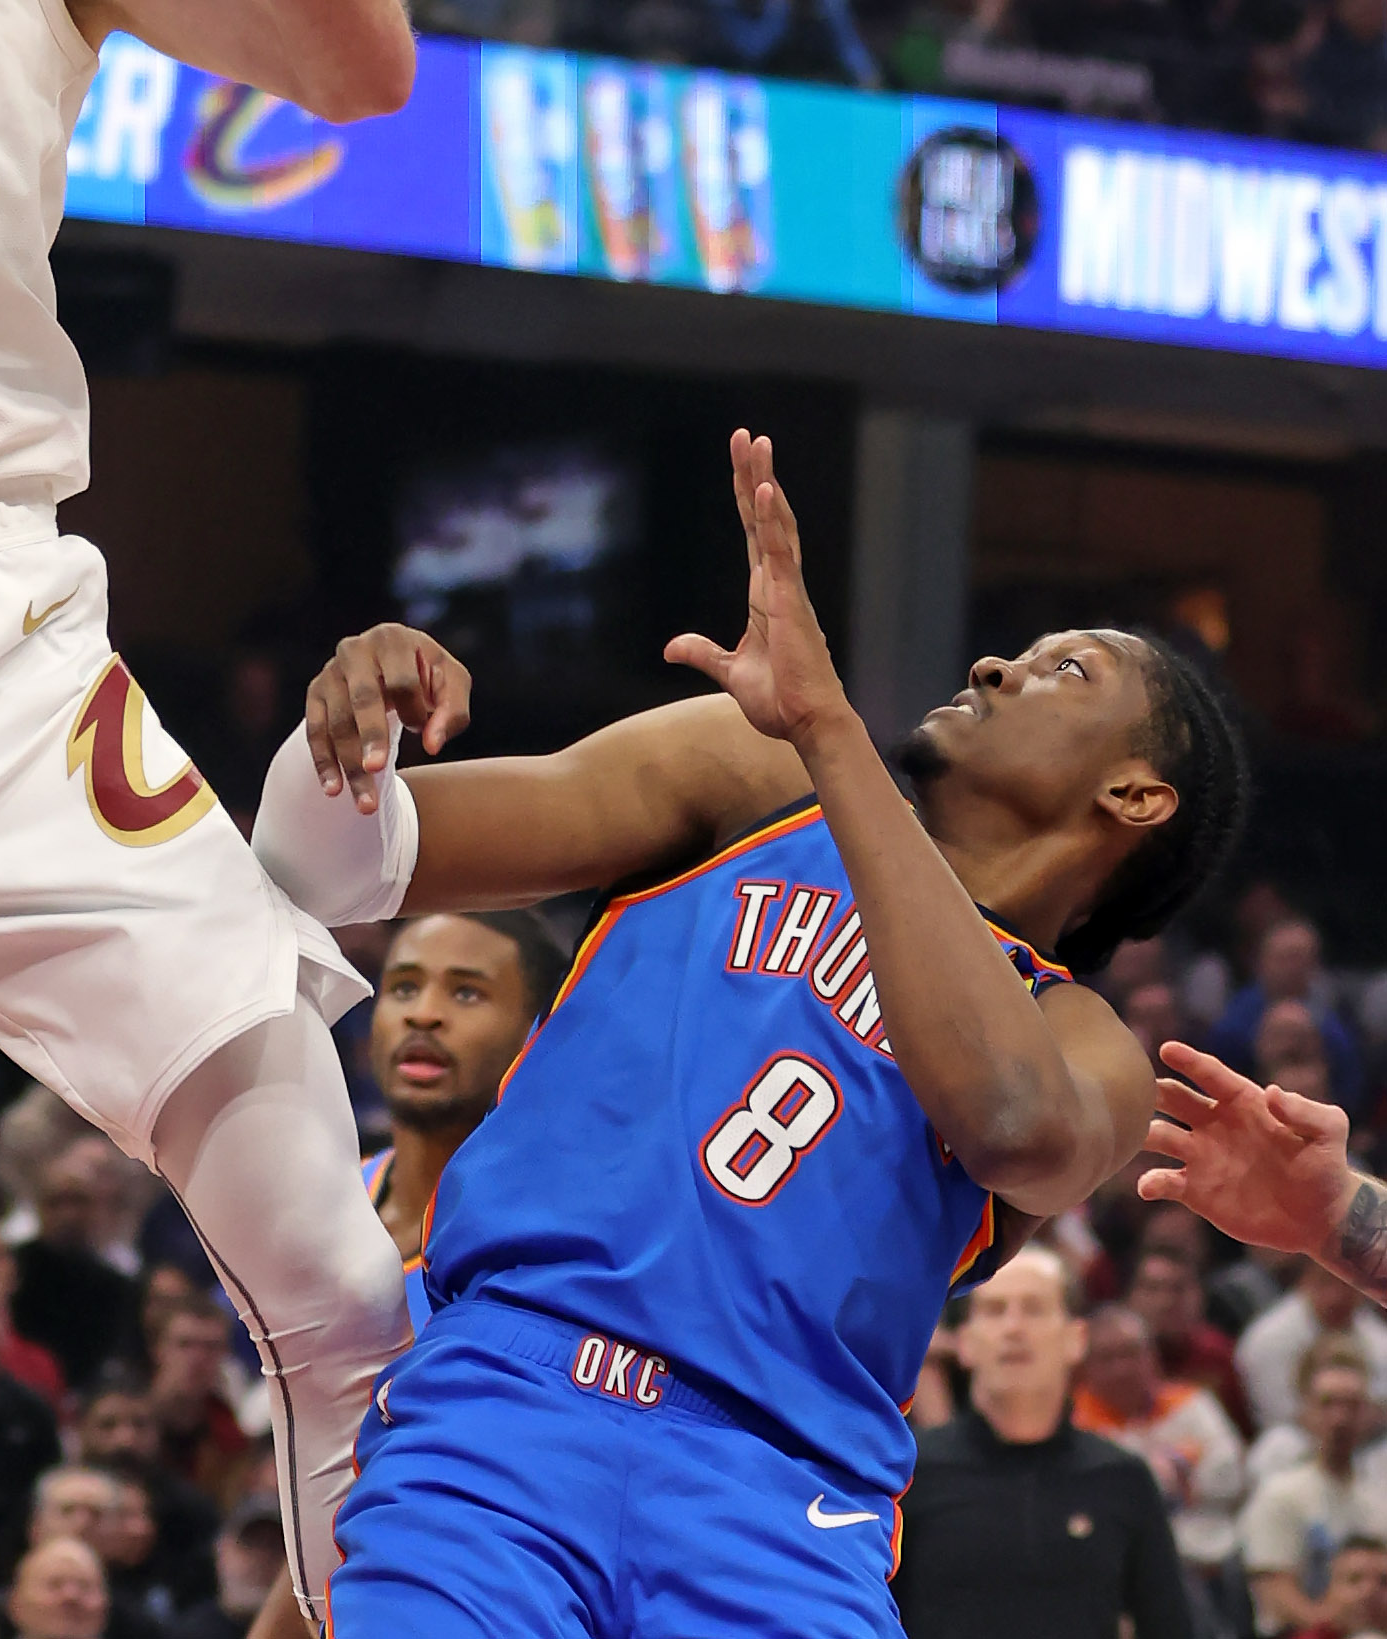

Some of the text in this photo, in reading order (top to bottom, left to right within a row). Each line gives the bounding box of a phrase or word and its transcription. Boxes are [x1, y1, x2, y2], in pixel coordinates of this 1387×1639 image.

[725, 878, 896, 1062] THUN
[698, 1048, 844, 1208] 8
[572, 1333, 671, 1408] OKC
